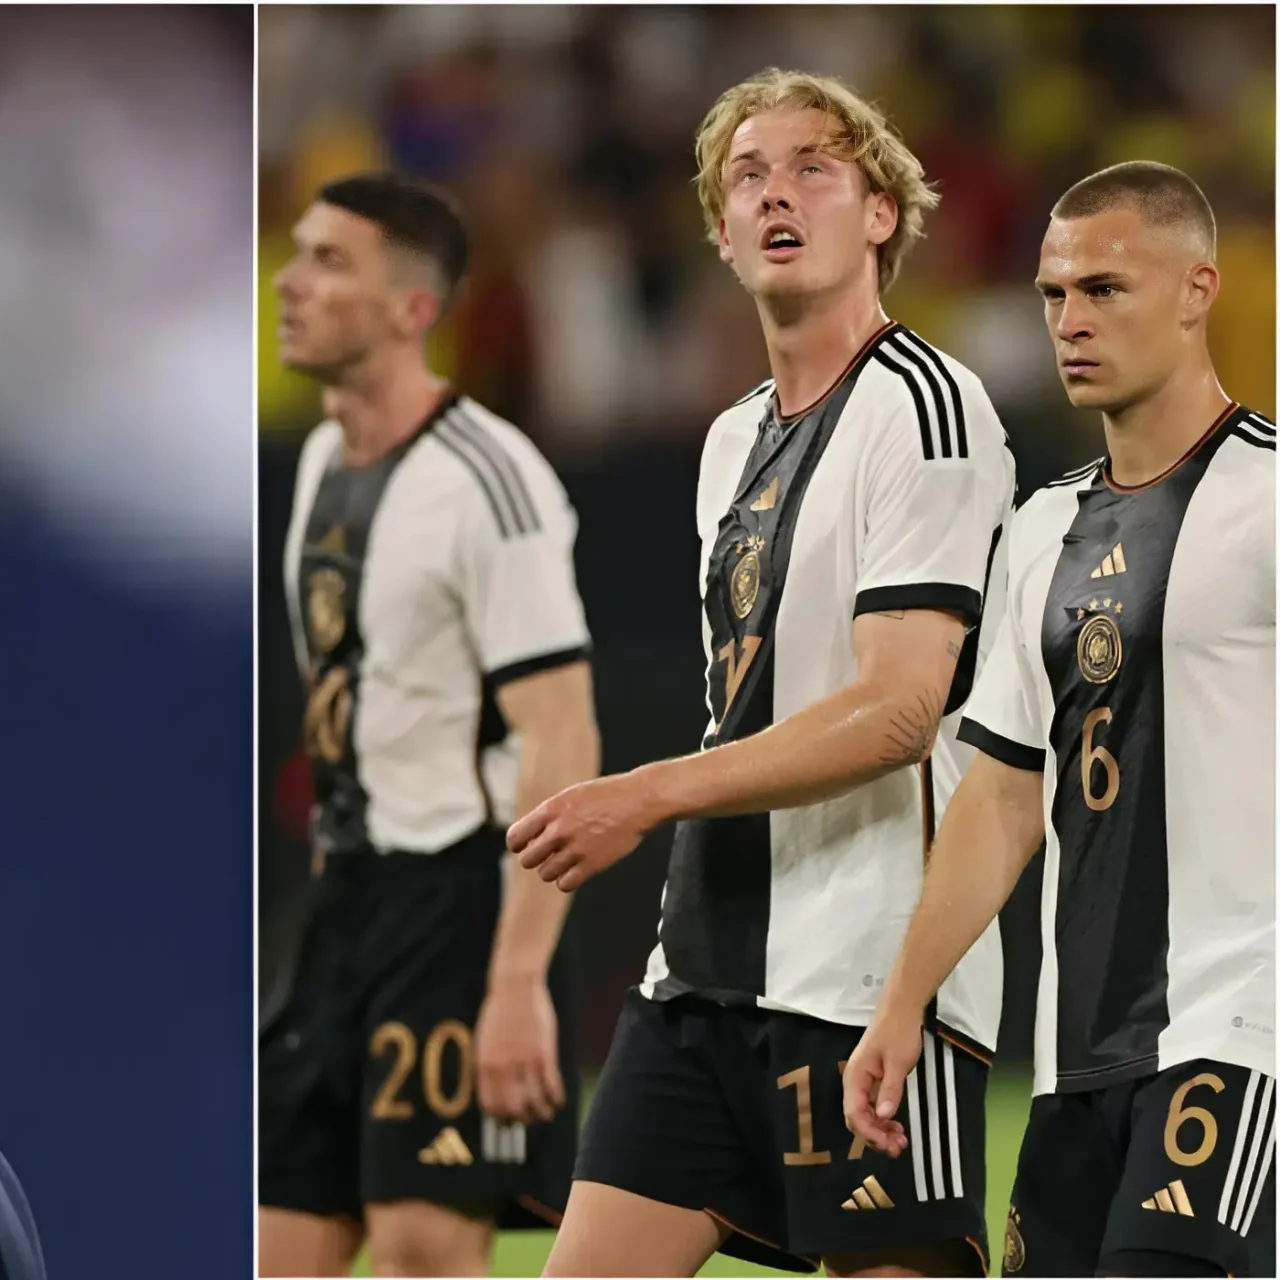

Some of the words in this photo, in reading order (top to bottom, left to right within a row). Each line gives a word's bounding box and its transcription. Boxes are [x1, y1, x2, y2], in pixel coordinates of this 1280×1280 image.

[1081, 706, 1120, 811] 6
[370, 1020, 477, 1119] 20
[777, 1060, 868, 1166] 1
[1164, 1073, 1226, 1167] 6
